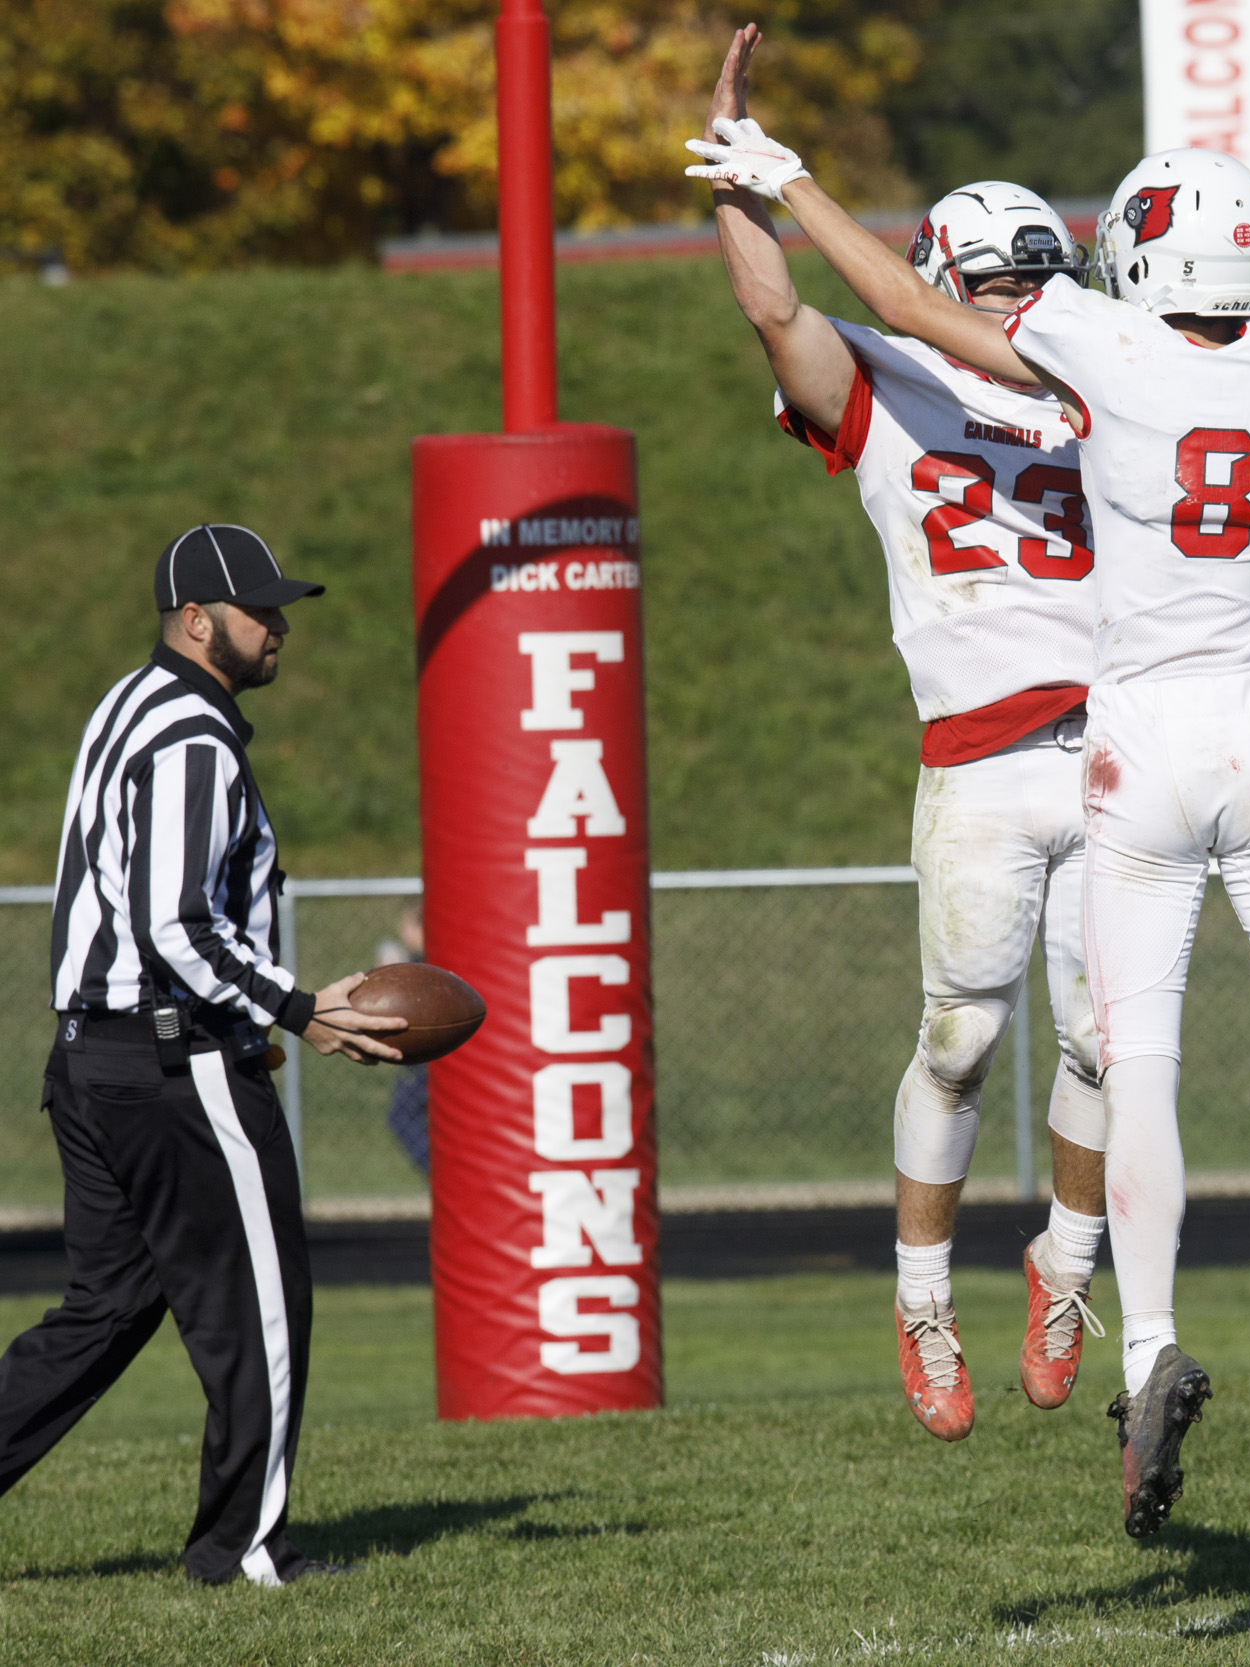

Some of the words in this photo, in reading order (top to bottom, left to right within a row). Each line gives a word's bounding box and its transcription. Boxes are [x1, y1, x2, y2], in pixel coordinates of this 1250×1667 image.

[964, 420, 1043, 449] CARDINALS
[911, 449, 1095, 582] 23
[479, 517, 511, 547] IN
[518, 516, 625, 546] MEMORY
[490, 562, 561, 592] DICK
[517, 630, 644, 1376] FALCONS
